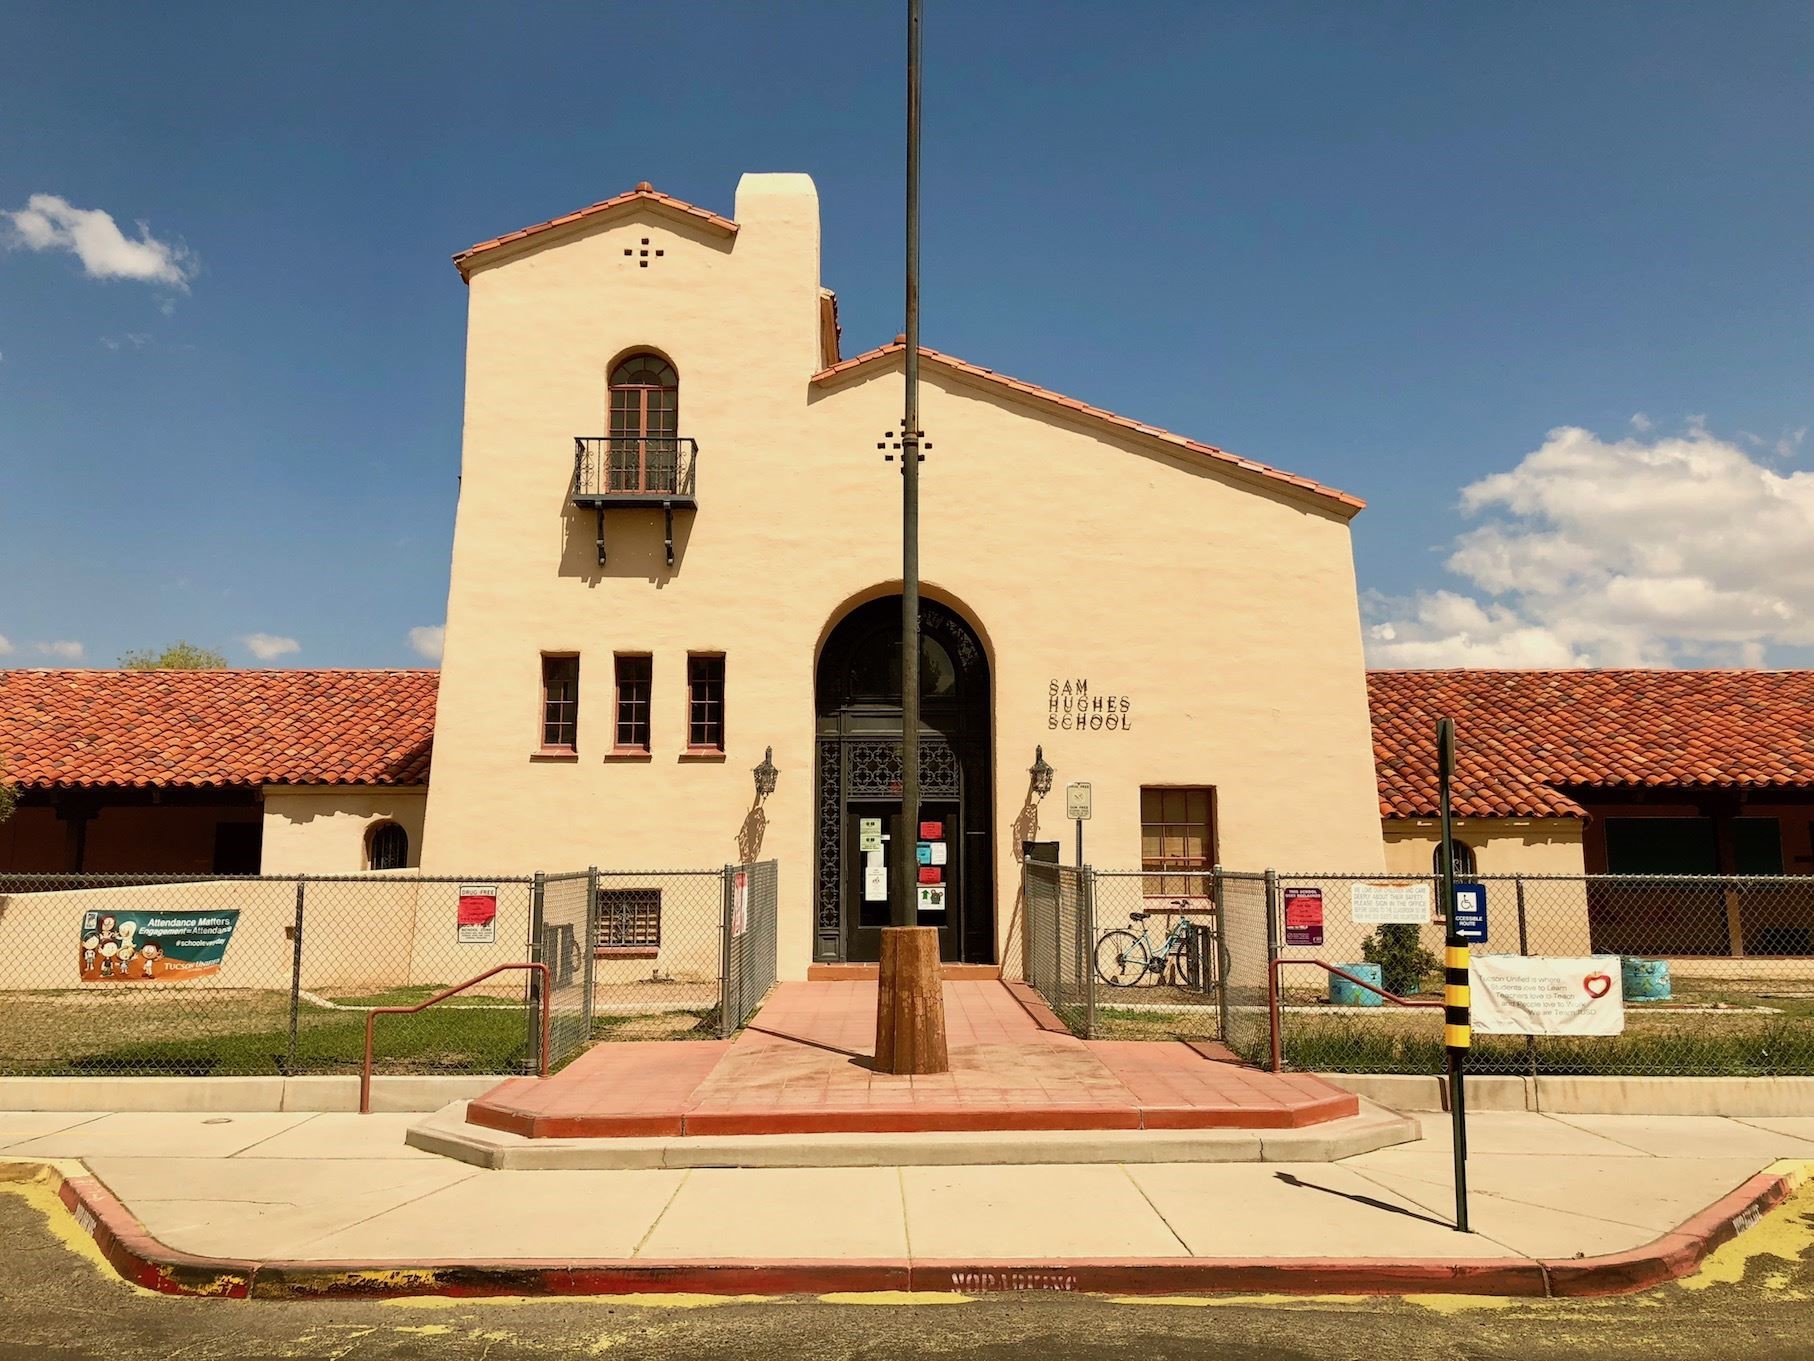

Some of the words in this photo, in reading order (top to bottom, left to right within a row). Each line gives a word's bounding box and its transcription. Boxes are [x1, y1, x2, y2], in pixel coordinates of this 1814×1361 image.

[1049, 679, 1087, 696] SAM
[1048, 696, 1130, 712] HUGHES
[1048, 713, 1131, 730] SCHOOL
[147, 918, 196, 926] Attendance
[197, 917, 230, 926] Matters
